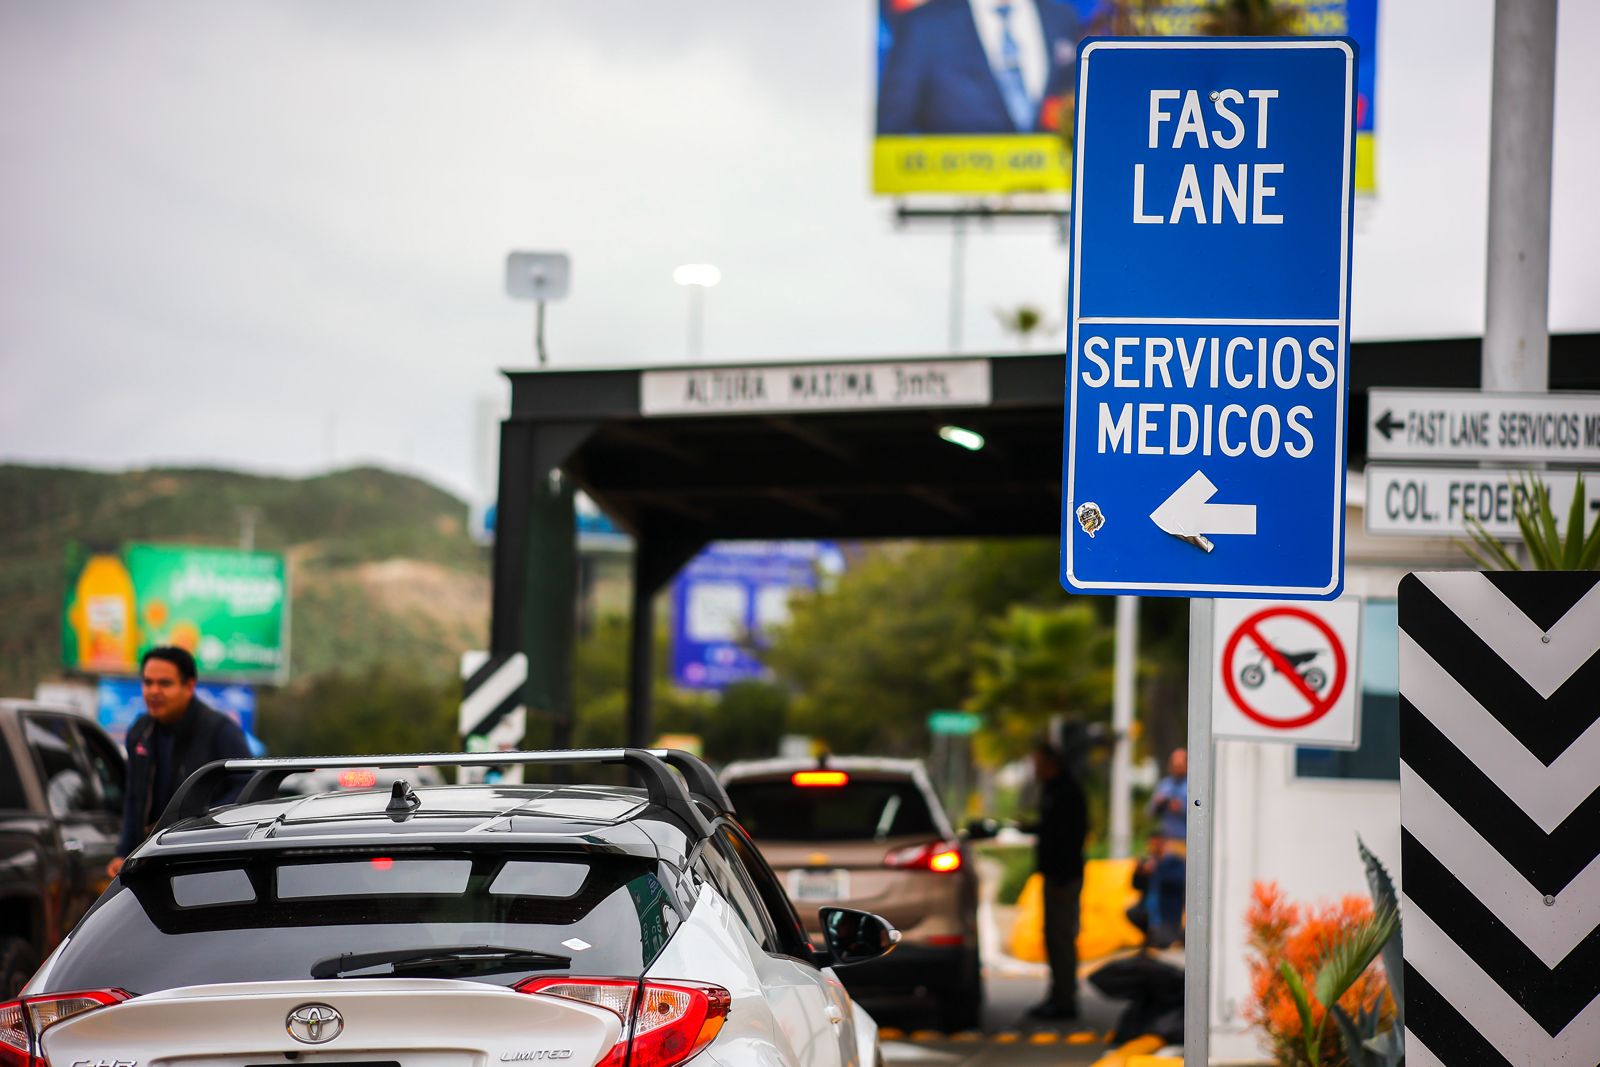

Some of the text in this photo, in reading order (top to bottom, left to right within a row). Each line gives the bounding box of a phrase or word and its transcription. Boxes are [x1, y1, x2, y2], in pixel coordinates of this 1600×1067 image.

[1149, 88, 1279, 149] FAST
[1133, 163, 1285, 224] LANE
[1081, 336, 1336, 390] SERVICIOS
[1097, 402, 1315, 458] MEDICOS
[1407, 409, 1447, 447] FAST
[1449, 410, 1490, 448] LANE
[1498, 411, 1580, 449] SERVICIOS
[1385, 479, 1440, 522] COL.
[500, 1049, 574, 1062] LIMITED
